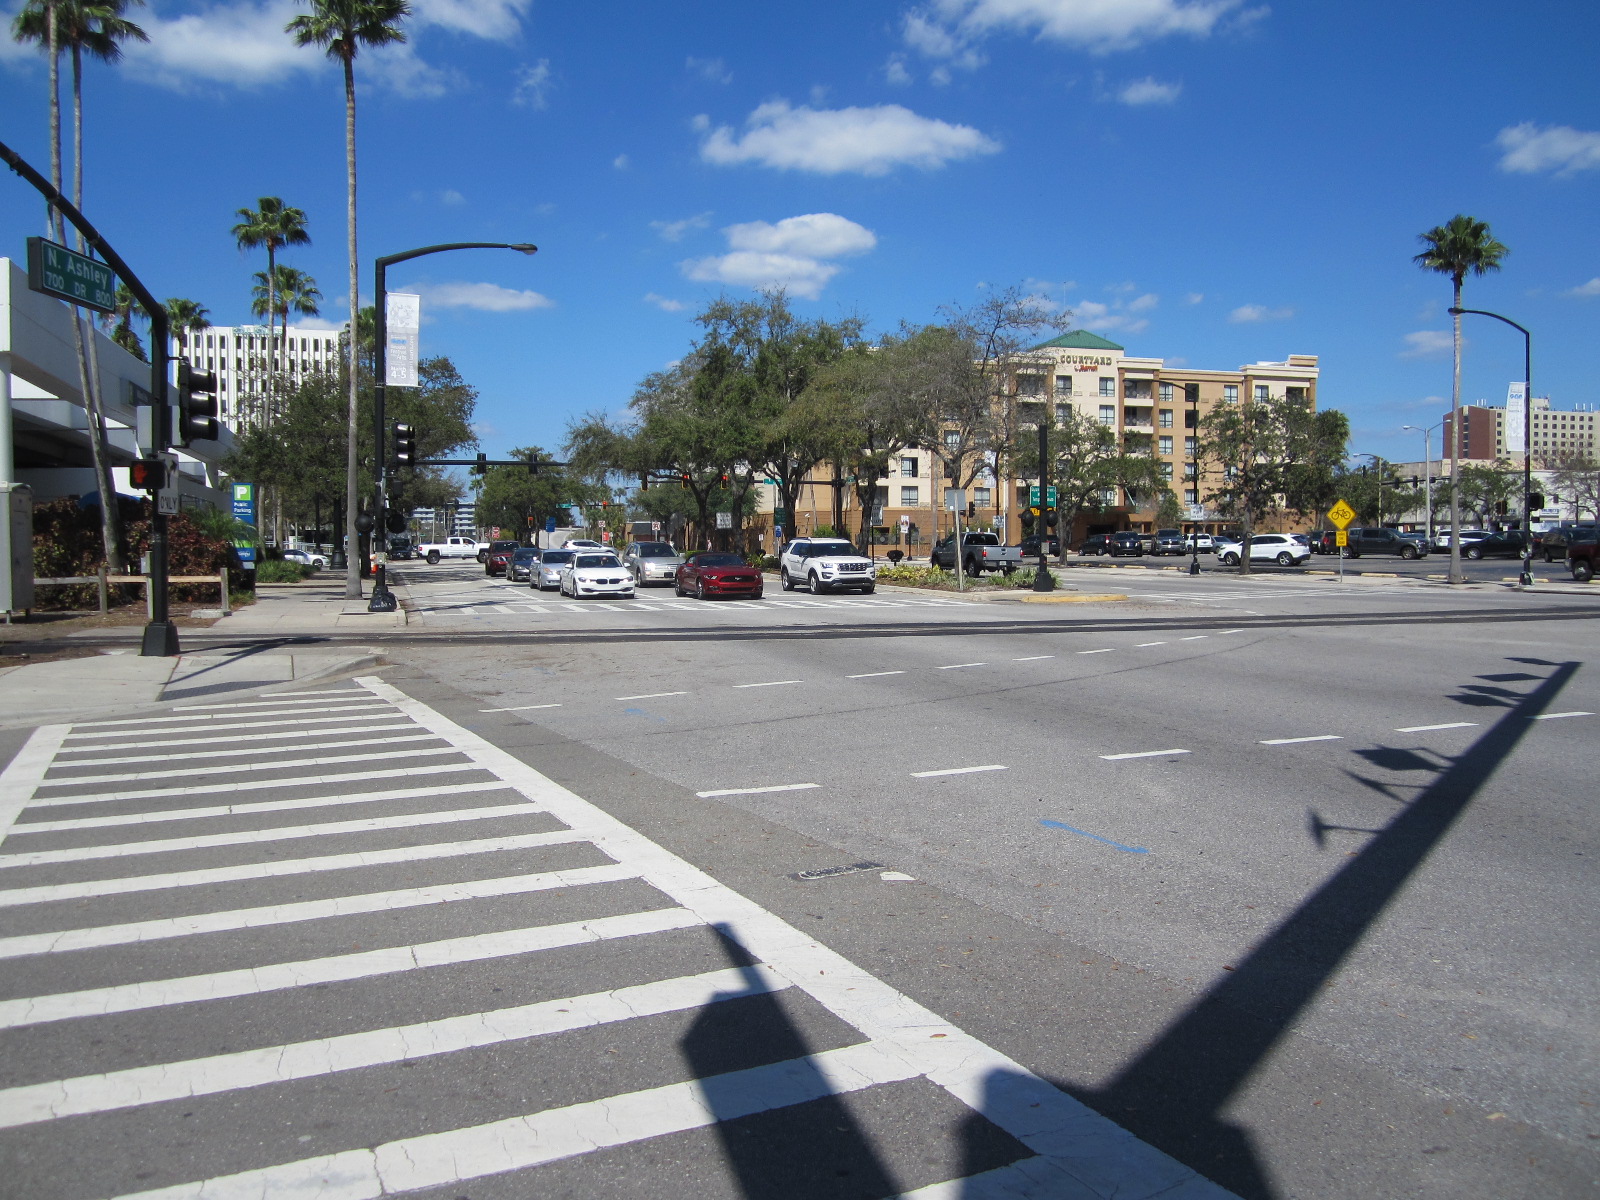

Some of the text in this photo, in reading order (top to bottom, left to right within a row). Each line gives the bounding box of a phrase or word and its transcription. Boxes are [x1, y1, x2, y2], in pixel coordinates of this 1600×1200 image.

[48, 247, 108, 290] N. Ashley
[45, 271, 111, 306] 700 DR 800
[1060, 354, 1112, 366] COURTYARD
[236, 486, 248, 499] P
[160, 495, 178, 510] ONLY
